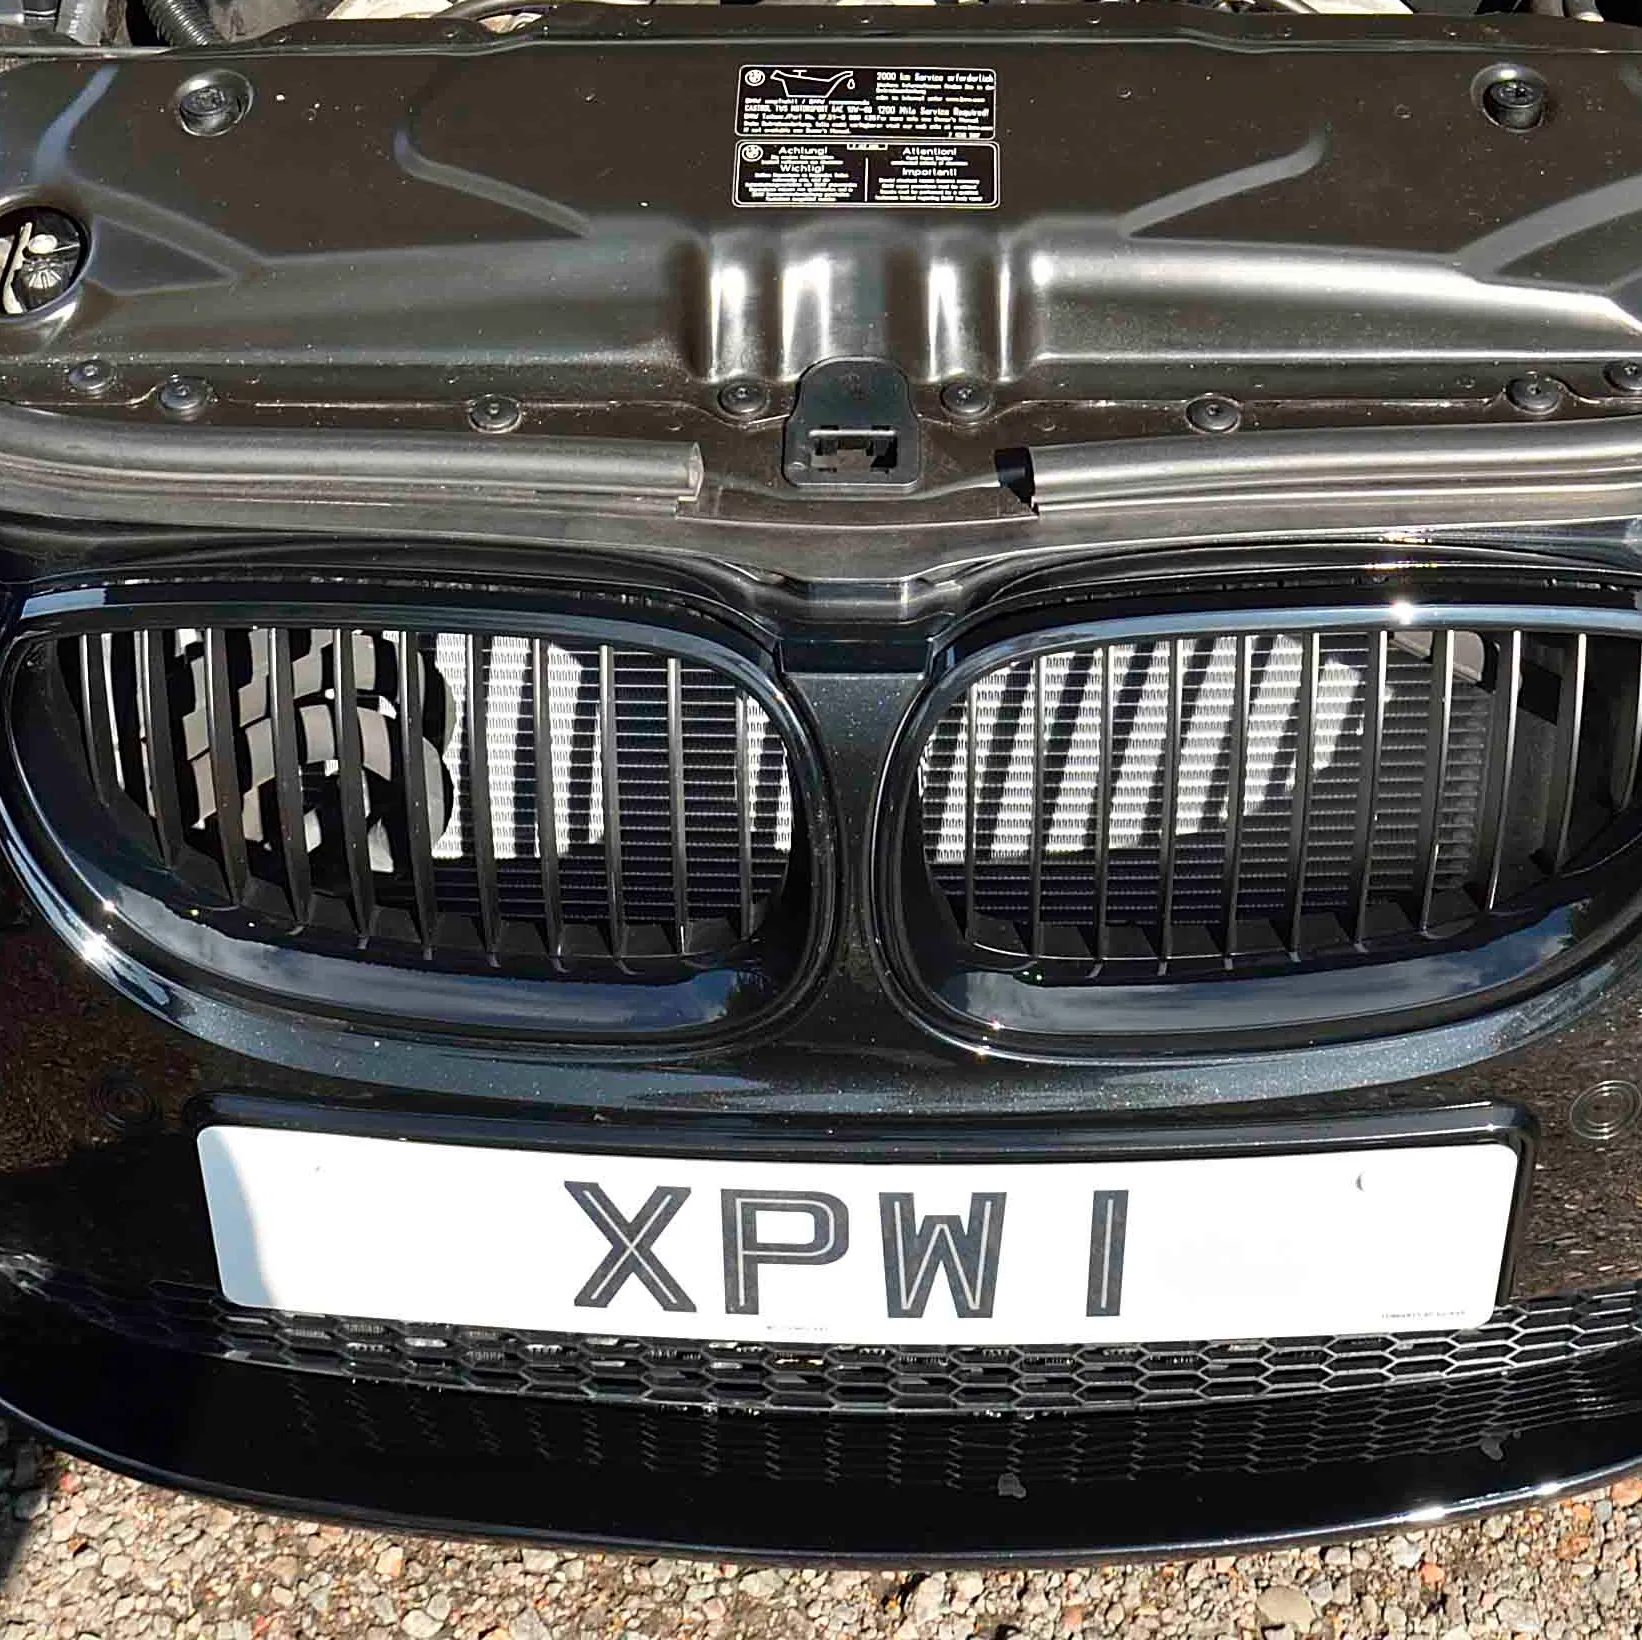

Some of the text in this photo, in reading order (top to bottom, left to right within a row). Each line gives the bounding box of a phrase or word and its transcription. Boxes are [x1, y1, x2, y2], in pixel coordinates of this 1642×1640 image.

[778, 146, 828, 156] Achtung!
[902, 147, 957, 156] Attention!
[779, 164, 825, 173] Wichtig!
[902, 167, 958, 177] Important!
[564, 1181, 1007, 1318] XPW
